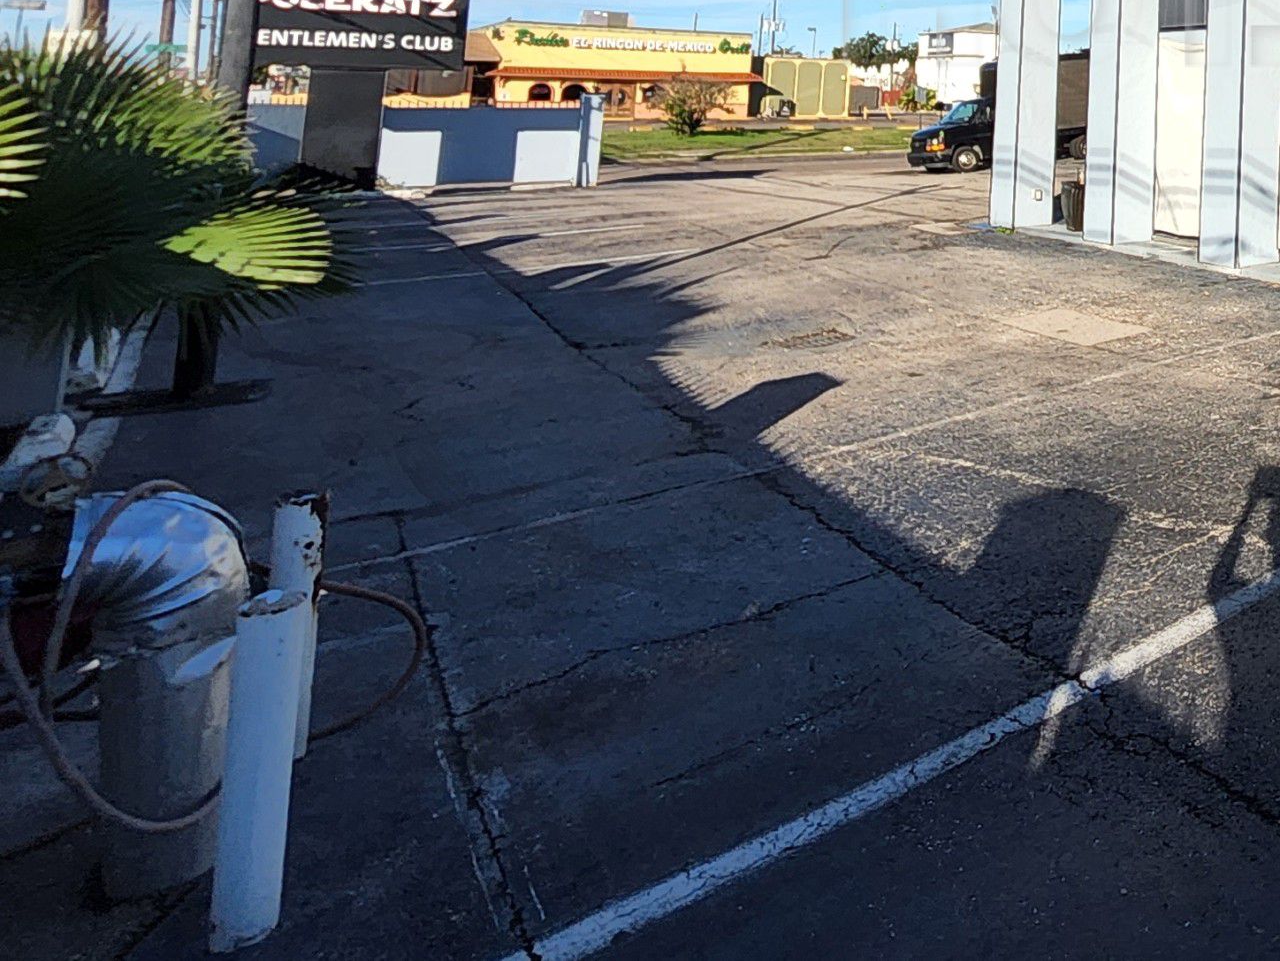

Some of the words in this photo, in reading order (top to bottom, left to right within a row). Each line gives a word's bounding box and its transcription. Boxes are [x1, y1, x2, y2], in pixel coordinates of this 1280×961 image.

[256, 28, 396, 50] ENTLEMEN'S
[400, 34, 454, 52] CLUB
[668, 40, 716, 54] MEXICO
